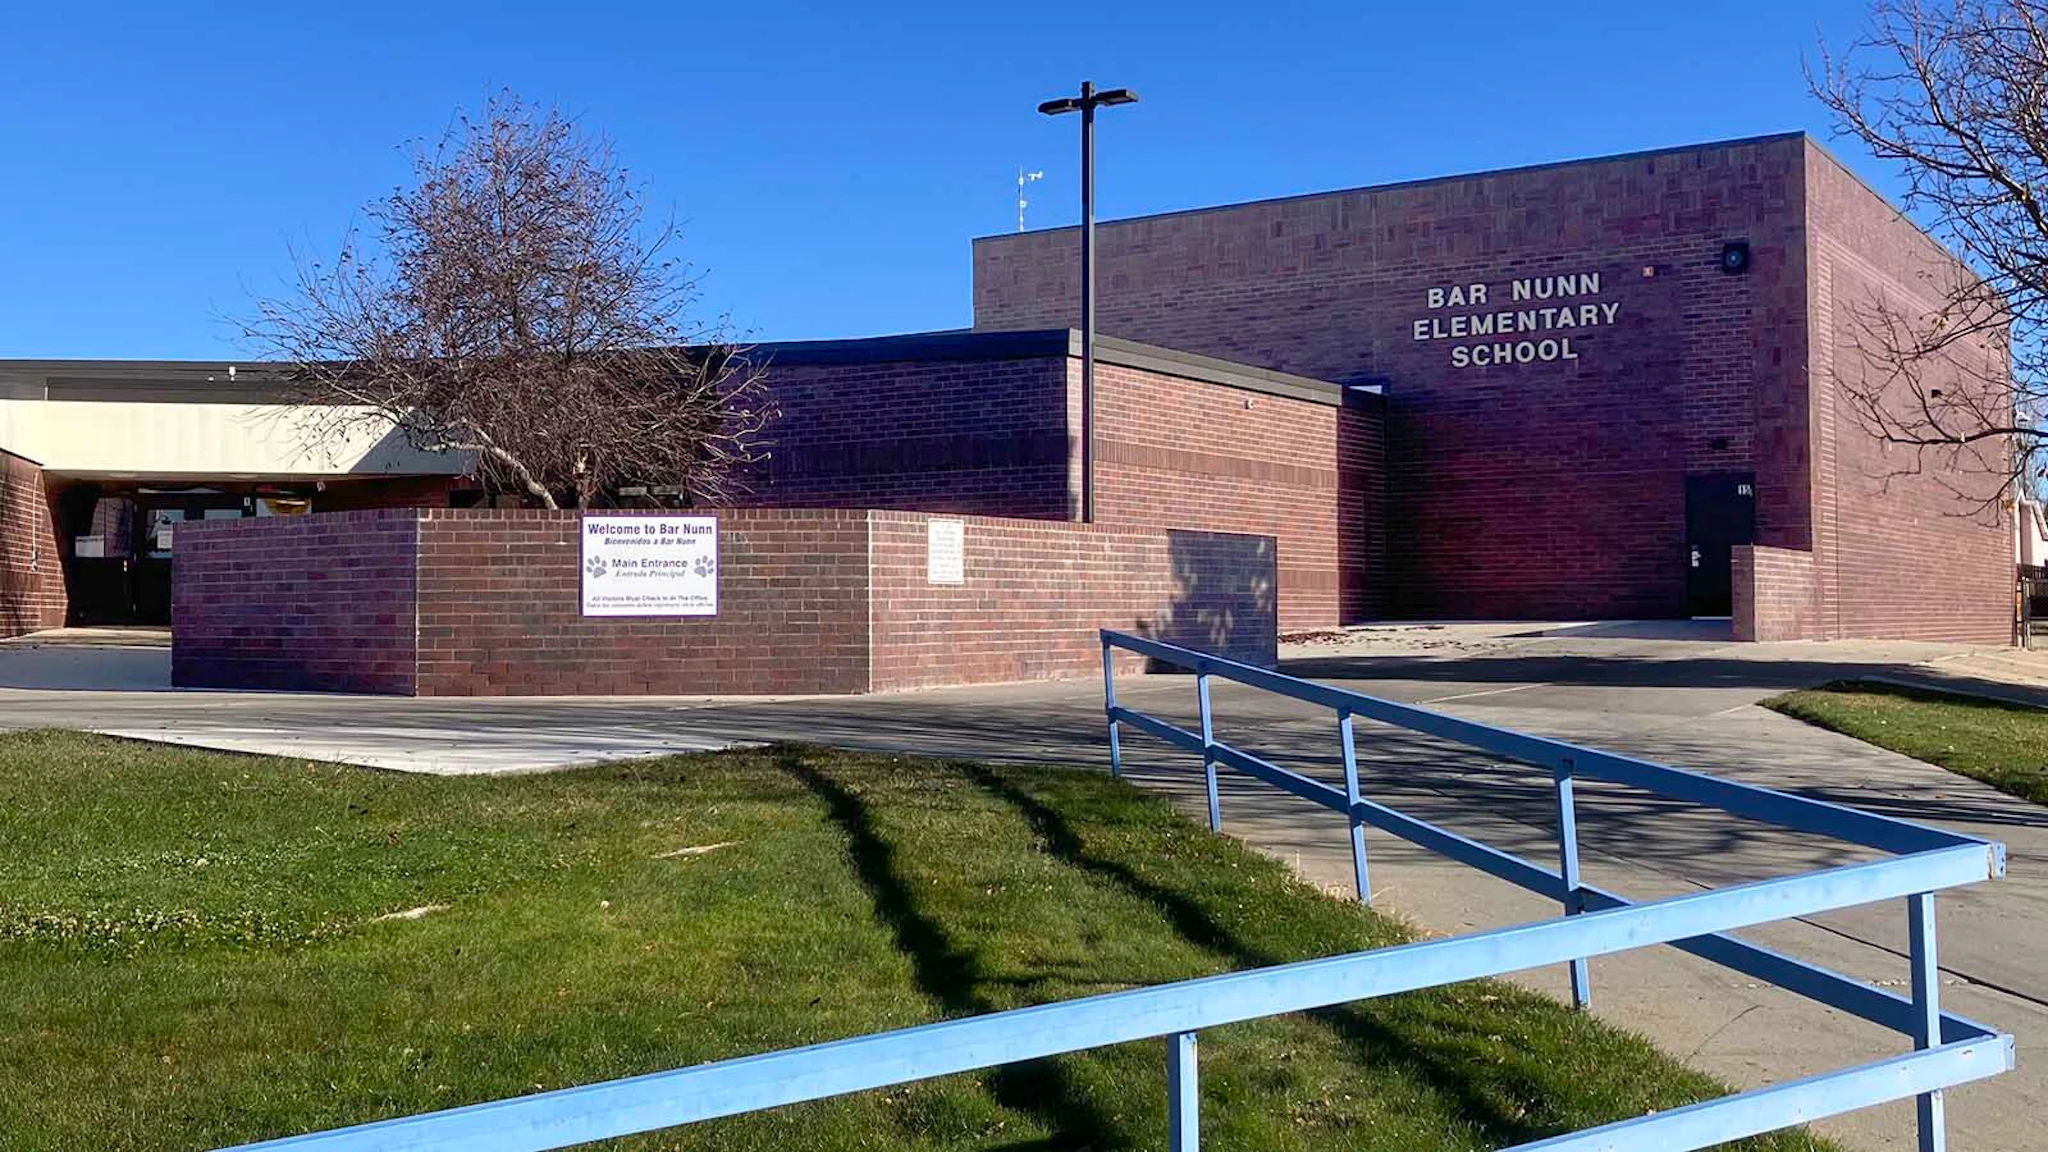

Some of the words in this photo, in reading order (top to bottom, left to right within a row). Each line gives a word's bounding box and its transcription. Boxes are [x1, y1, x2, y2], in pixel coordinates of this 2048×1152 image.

[1427, 283, 1488, 309] BAR
[1512, 272, 1600, 301] NUNN
[1413, 302, 1619, 341] ELEMENTARY
[1451, 337, 1578, 368] SCHOOL
[588, 523, 640, 534] Welcome
[644, 524, 656, 535] to
[659, 523, 679, 534] Bar
[683, 523, 713, 534] Nunn
[604, 537, 650, 545] Bienvenidos
[660, 537, 674, 545] Bar
[676, 537, 696, 545] Nunn
[611, 558, 638, 568] Main
[641, 558, 688, 568] Entrance
[649, 570, 685, 578] Principal
